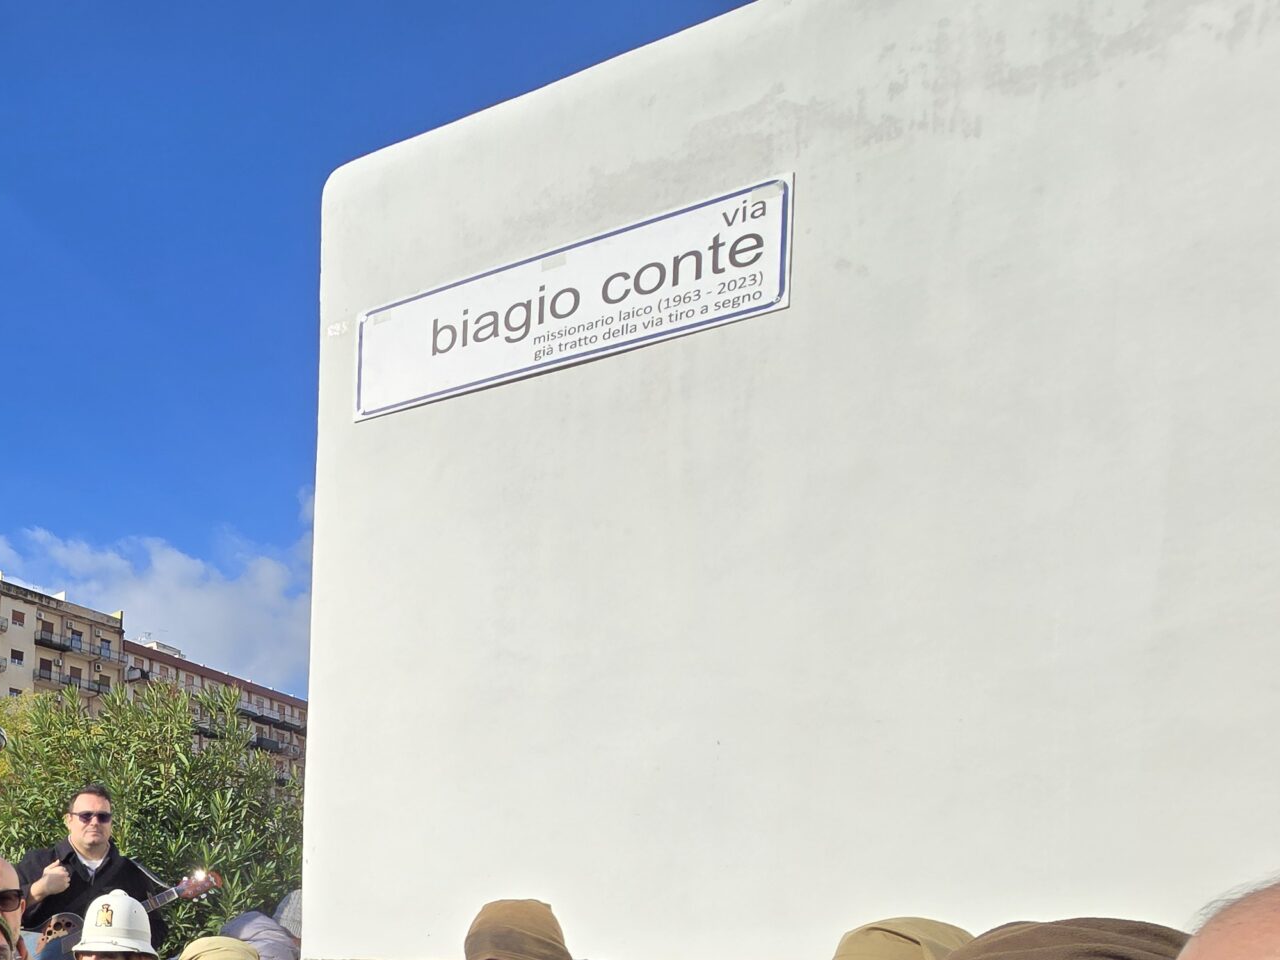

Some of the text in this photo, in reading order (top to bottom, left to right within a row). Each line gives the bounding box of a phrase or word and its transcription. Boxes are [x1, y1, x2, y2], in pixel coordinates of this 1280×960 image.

[722, 200, 766, 227] via
[431, 233, 765, 356] biagio conte
[533, 316, 614, 345] missionario
[618, 305, 653, 322] laico
[658, 289, 701, 313] (1963
[717, 271, 764, 295] 2023)
[534, 290, 762, 361] già tratto della via tiro a segno
